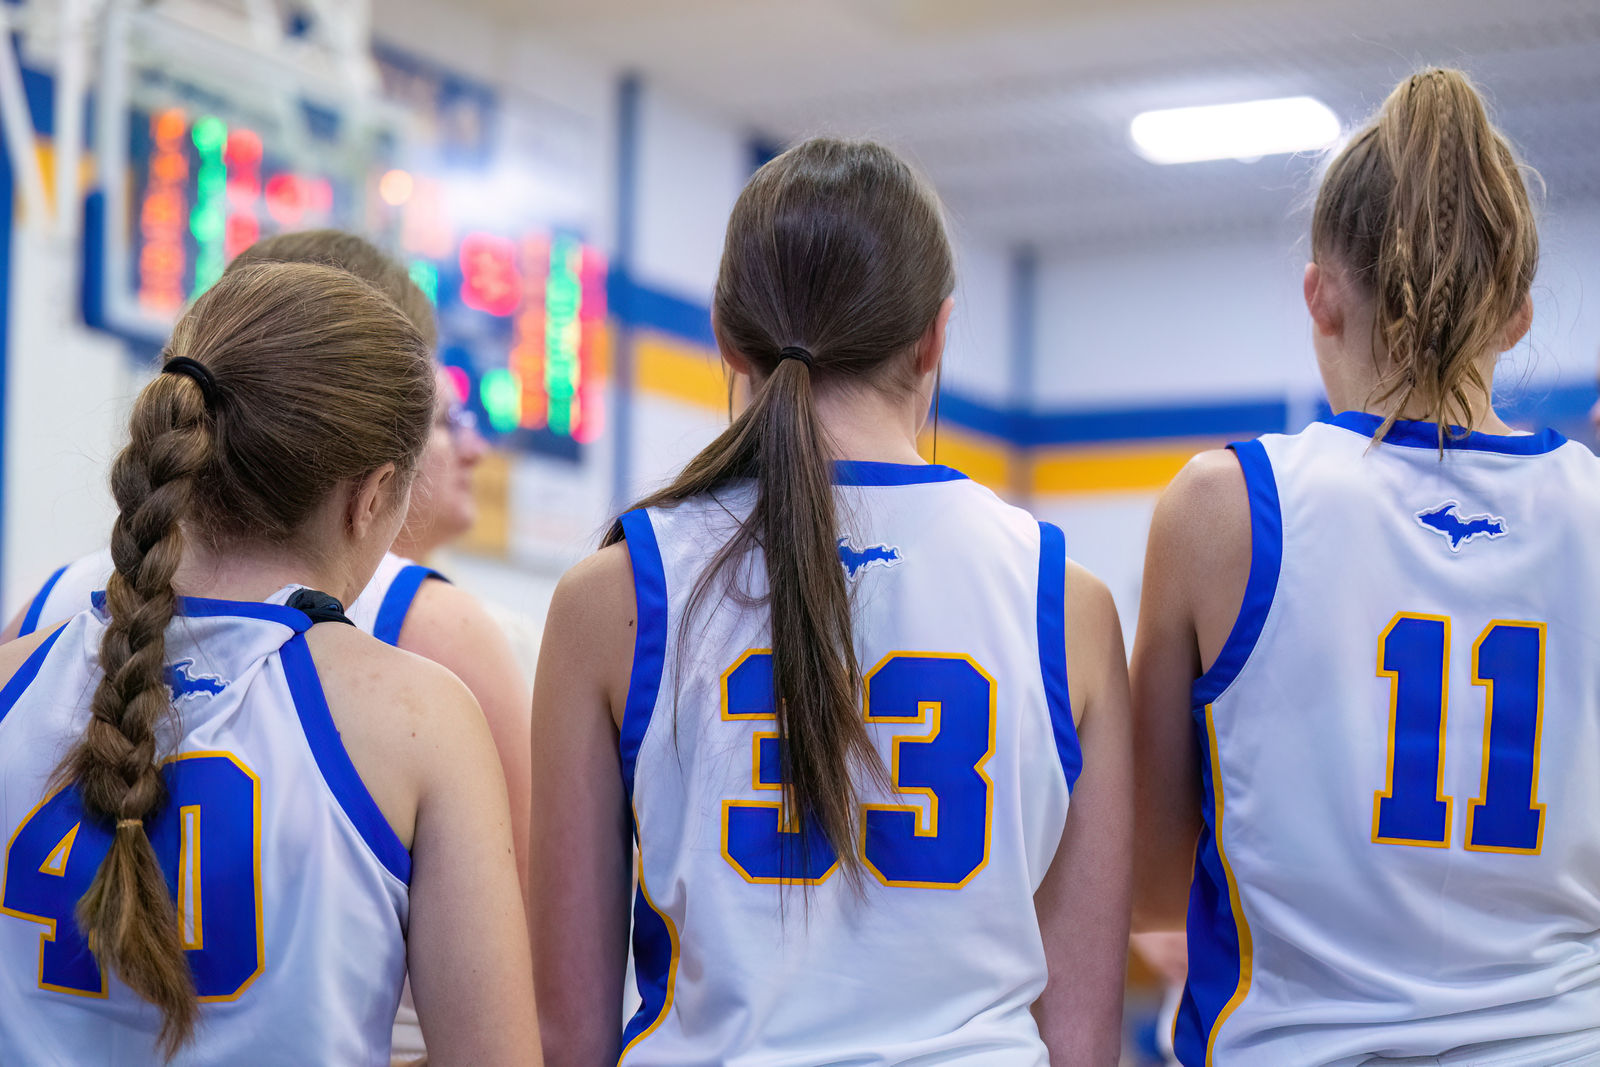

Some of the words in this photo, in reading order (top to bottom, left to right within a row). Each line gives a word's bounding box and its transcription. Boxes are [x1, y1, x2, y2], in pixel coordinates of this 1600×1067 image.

[720, 648, 998, 890] 33
[1371, 611, 1547, 855] 11
[0, 751, 265, 1003] 40
